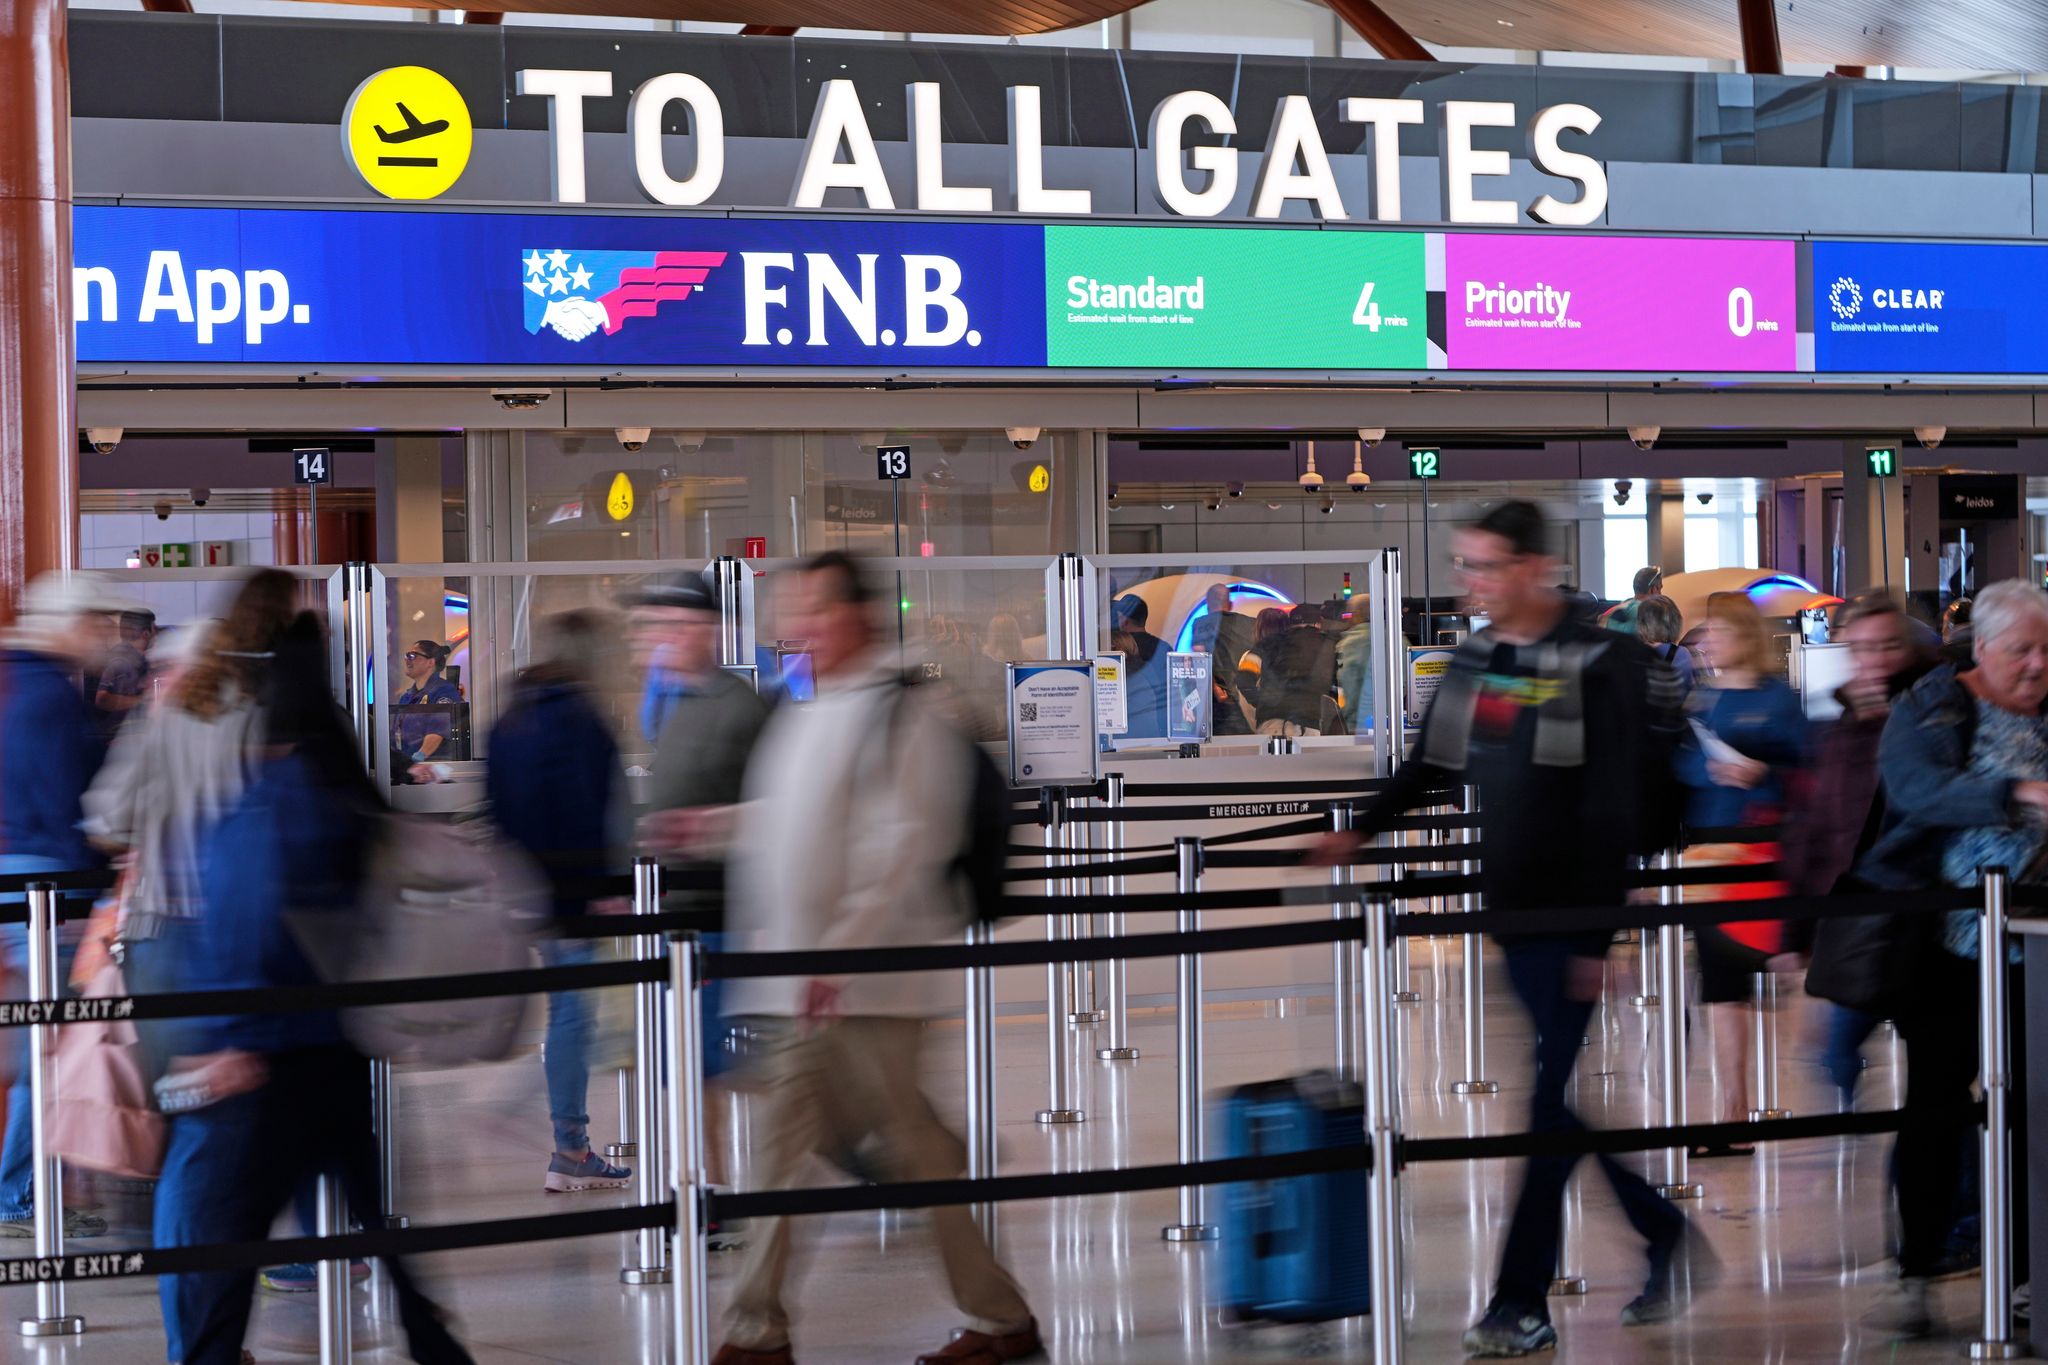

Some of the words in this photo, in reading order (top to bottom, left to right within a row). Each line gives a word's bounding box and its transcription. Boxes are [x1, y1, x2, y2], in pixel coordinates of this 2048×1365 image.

[516, 69, 724, 206] TO
[790, 79, 1092, 213] ALL
[1147, 90, 1608, 225] GATES
[138, 250, 310, 344] App.
[740, 252, 982, 347] F.N.B.
[1066, 275, 1204, 310] Standard
[1465, 281, 1572, 322] Priority
[1872, 288, 1943, 309] CLEAR
[1067, 313, 1108, 323] Estimated
[1109, 314, 1127, 323] wait
[1128, 314, 1148, 323] from
[1149, 315, 1168, 323] start
[1169, 314, 1178, 323] of
[1179, 314, 1194, 324] line
[1352, 282, 1382, 332] 4
[1384, 314, 1408, 327] mins
[1728, 287, 1753, 337] 0
[1756, 318, 1779, 331] mins
[1465, 317, 1503, 328] Estimated
[1503, 318, 1520, 328] wait
[1521, 318, 1539, 328] from
[1540, 318, 1558, 328] start
[1567, 319, 1582, 328] line
[1831, 321, 1866, 332] Estimated
[1866, 322, 1881, 332] wait
[1882, 322, 1899, 332] from
[1900, 322, 1917, 332] start
[1917, 322, 1925, 332] of
[1925, 322, 1939, 332] line
[297, 453, 325, 479] 14
[881, 450, 907, 475] 13
[1411, 451, 1437, 476] 12
[1870, 450, 1891, 475] 11
[841, 507, 876, 519] leidos
[1966, 496, 1995, 508] leidos
[921, 662, 942, 678] TSA
[1172, 667, 1197, 679] REAL
[1197, 667, 1206, 679] ID
[1209, 804, 1272, 817] EMERGENCY
[1276, 802, 1299, 814] EXIT
[64, 1000, 112, 1020] EXIT
[74, 1254, 122, 1277] EXIT
